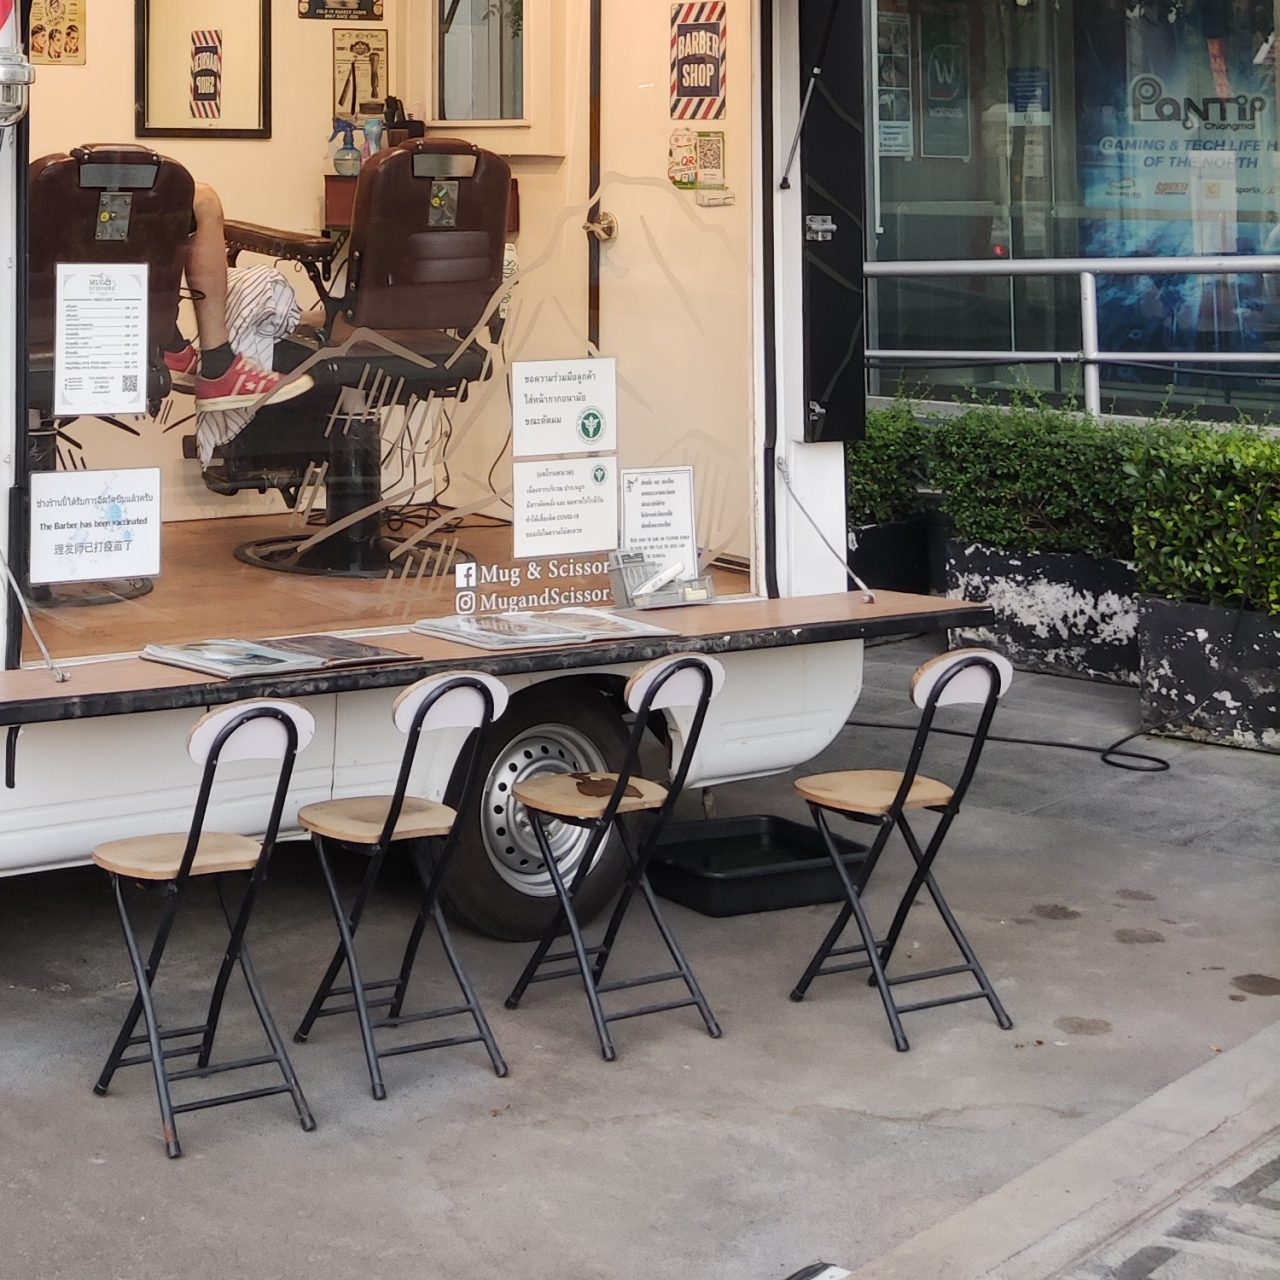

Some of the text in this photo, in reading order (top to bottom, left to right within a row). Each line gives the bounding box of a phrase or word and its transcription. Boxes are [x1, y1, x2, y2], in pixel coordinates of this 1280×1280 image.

[678, 30, 719, 59] BARBER
[682, 64, 715, 87] SHOP
[1204, 122, 1255, 131] Chiangmai
[1102, 139, 1165, 151] GAMING
[1184, 139, 1227, 151] TECH
[1229, 139, 1261, 151] LIFE
[1143, 156, 1165, 168] OF
[1169, 157, 1197, 168] THE
[40, 523, 53, 531] The
[54, 522, 78, 530] Barber
[112, 517, 148, 526] vaccinated
[480, 559, 610, 587] Mug & Scissor
